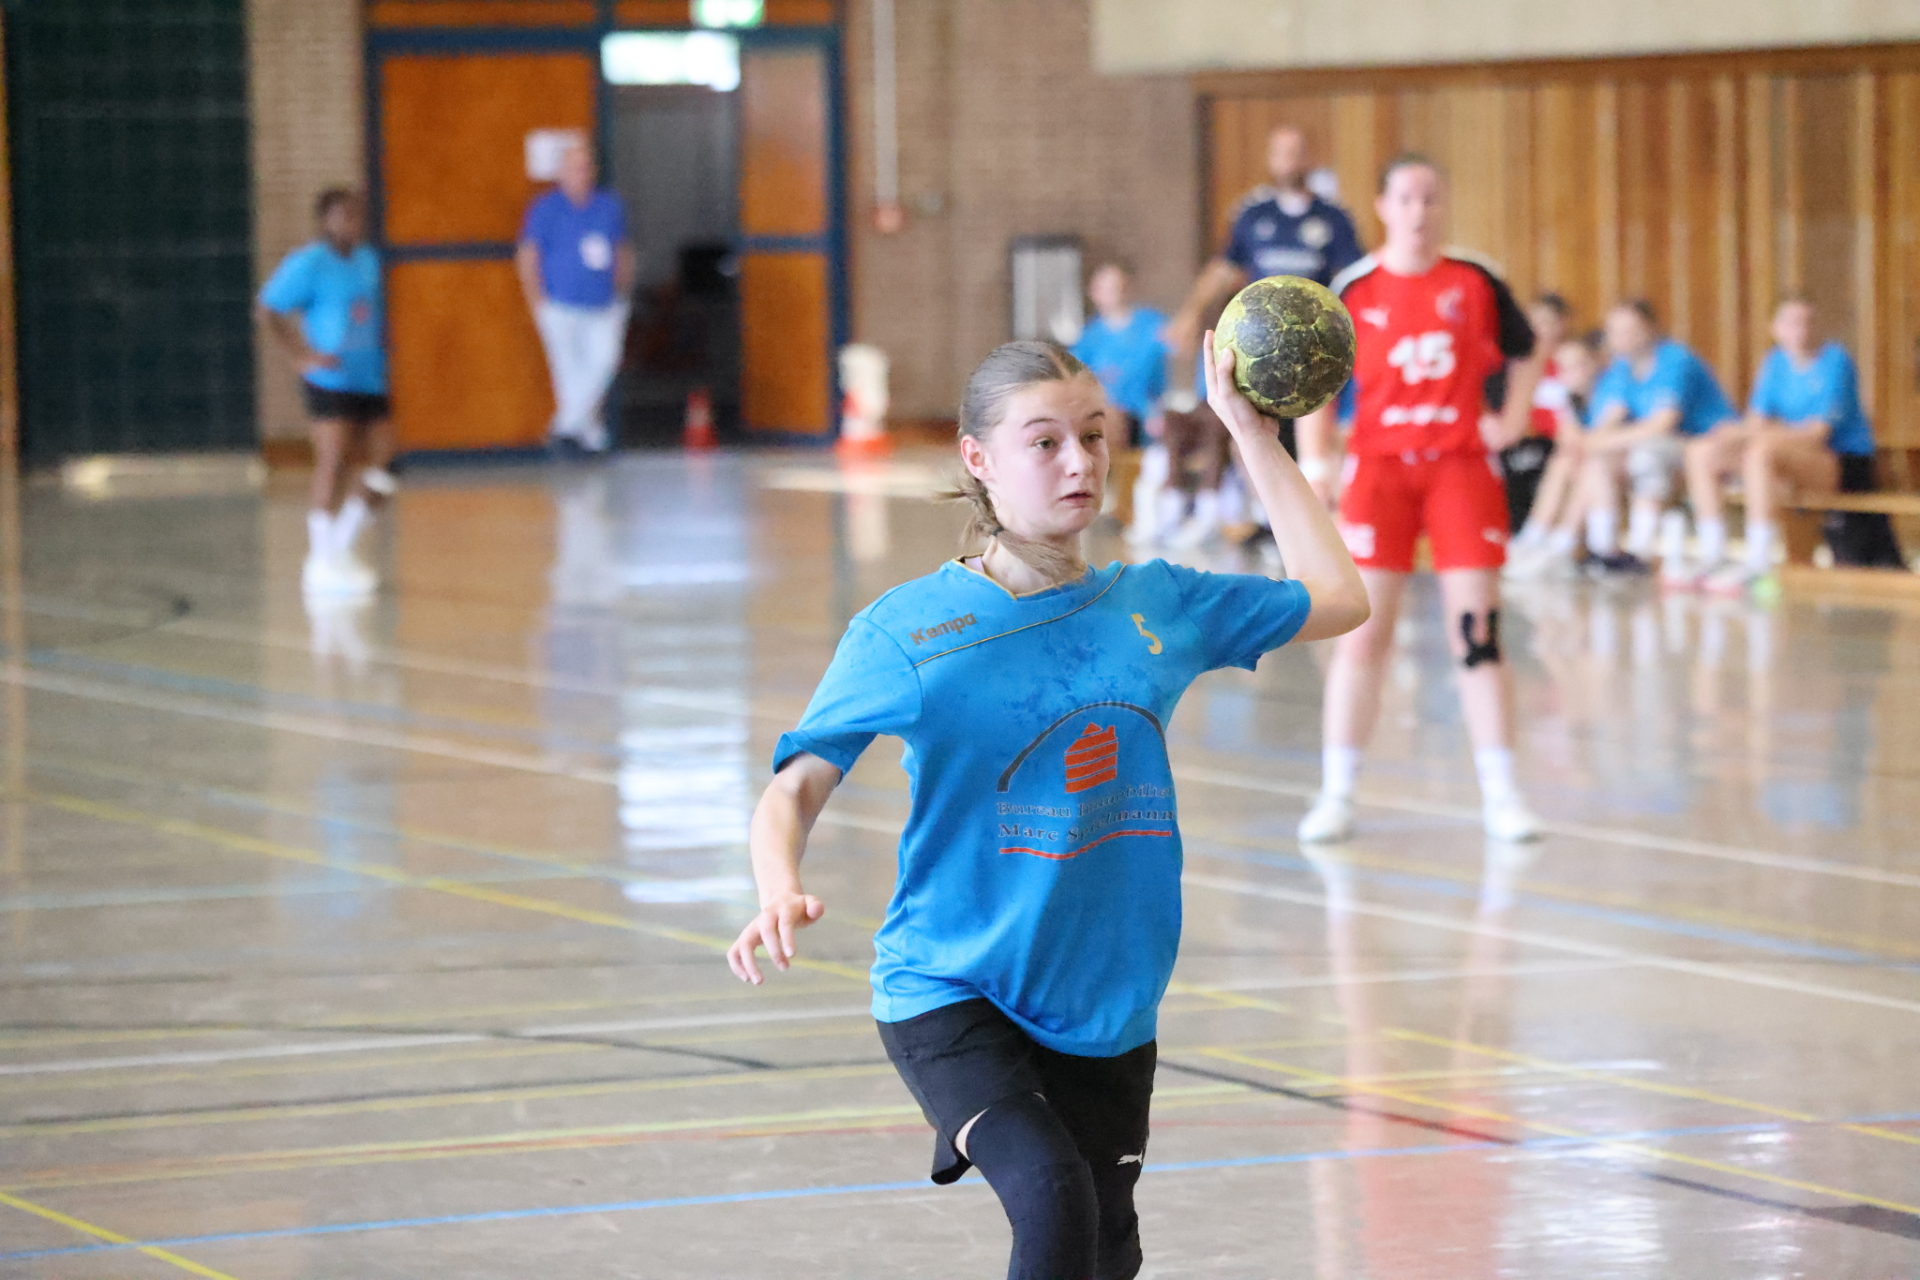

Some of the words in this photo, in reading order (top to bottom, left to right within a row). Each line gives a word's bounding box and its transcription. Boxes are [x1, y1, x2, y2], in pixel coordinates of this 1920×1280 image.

[908, 612, 978, 646] Kempa
[1130, 612, 1163, 655] 5
[996, 801, 1071, 818] Bureau
[998, 823, 1059, 842] Marc
